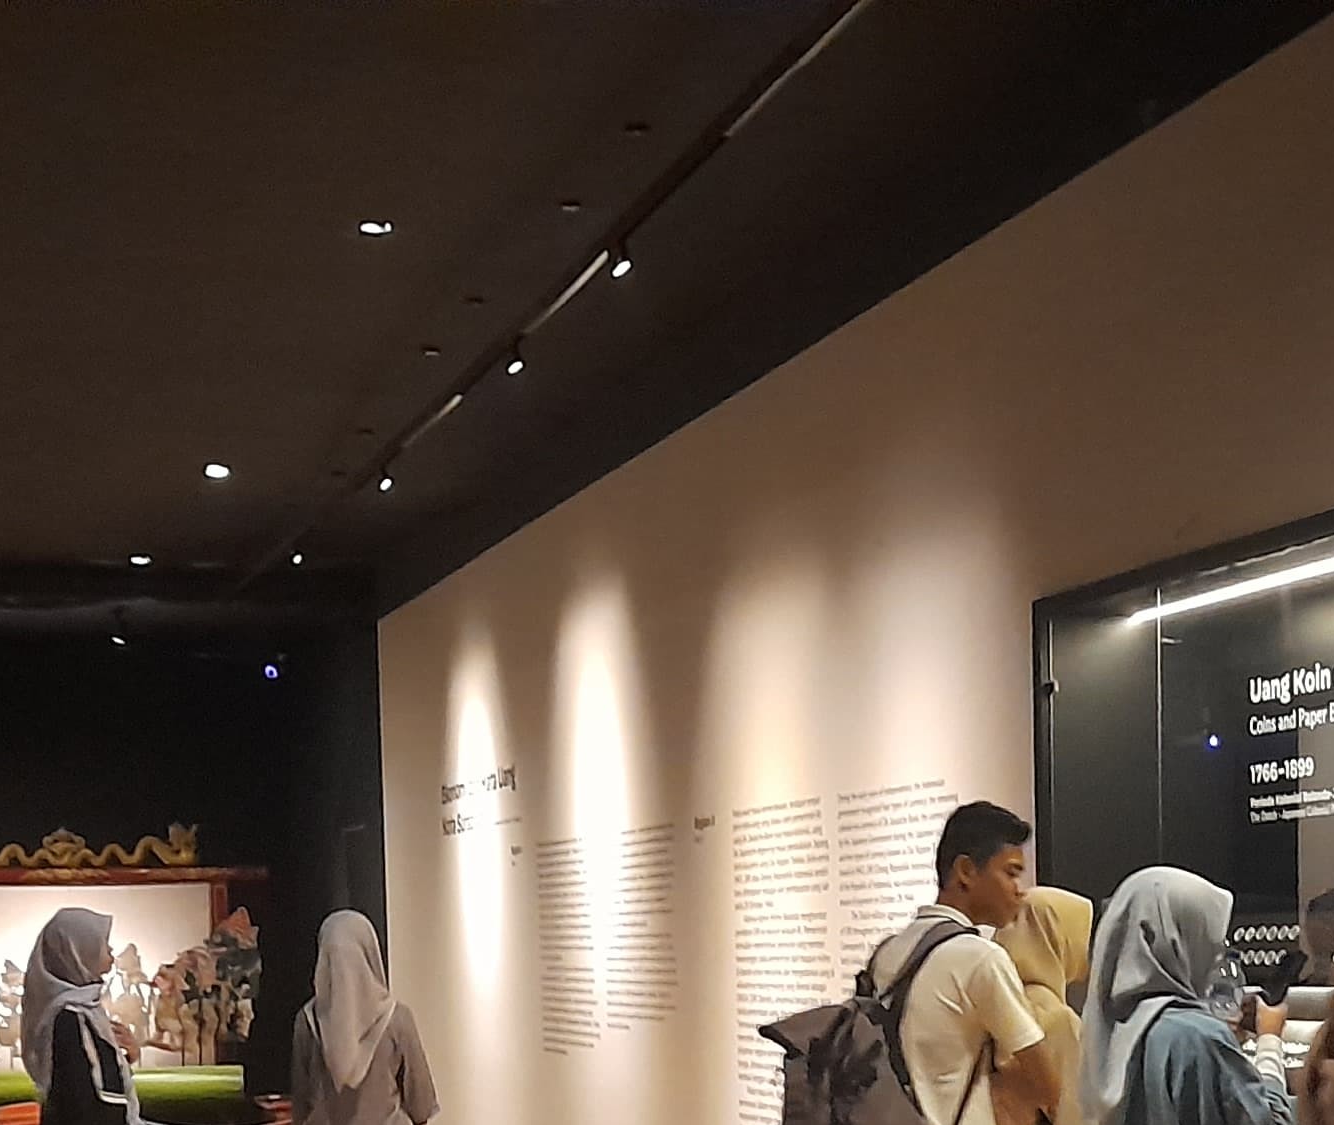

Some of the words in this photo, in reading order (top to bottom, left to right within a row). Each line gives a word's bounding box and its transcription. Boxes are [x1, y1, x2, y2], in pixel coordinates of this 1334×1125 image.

[1249, 672, 1291, 704] Uang
[1293, 662, 1331, 695] Koin
[1249, 715, 1276, 736] Coins
[1278, 709, 1296, 731] and
[1298, 704, 1327, 730] Paper
[1249, 757, 1315, 784] 1766-1899
